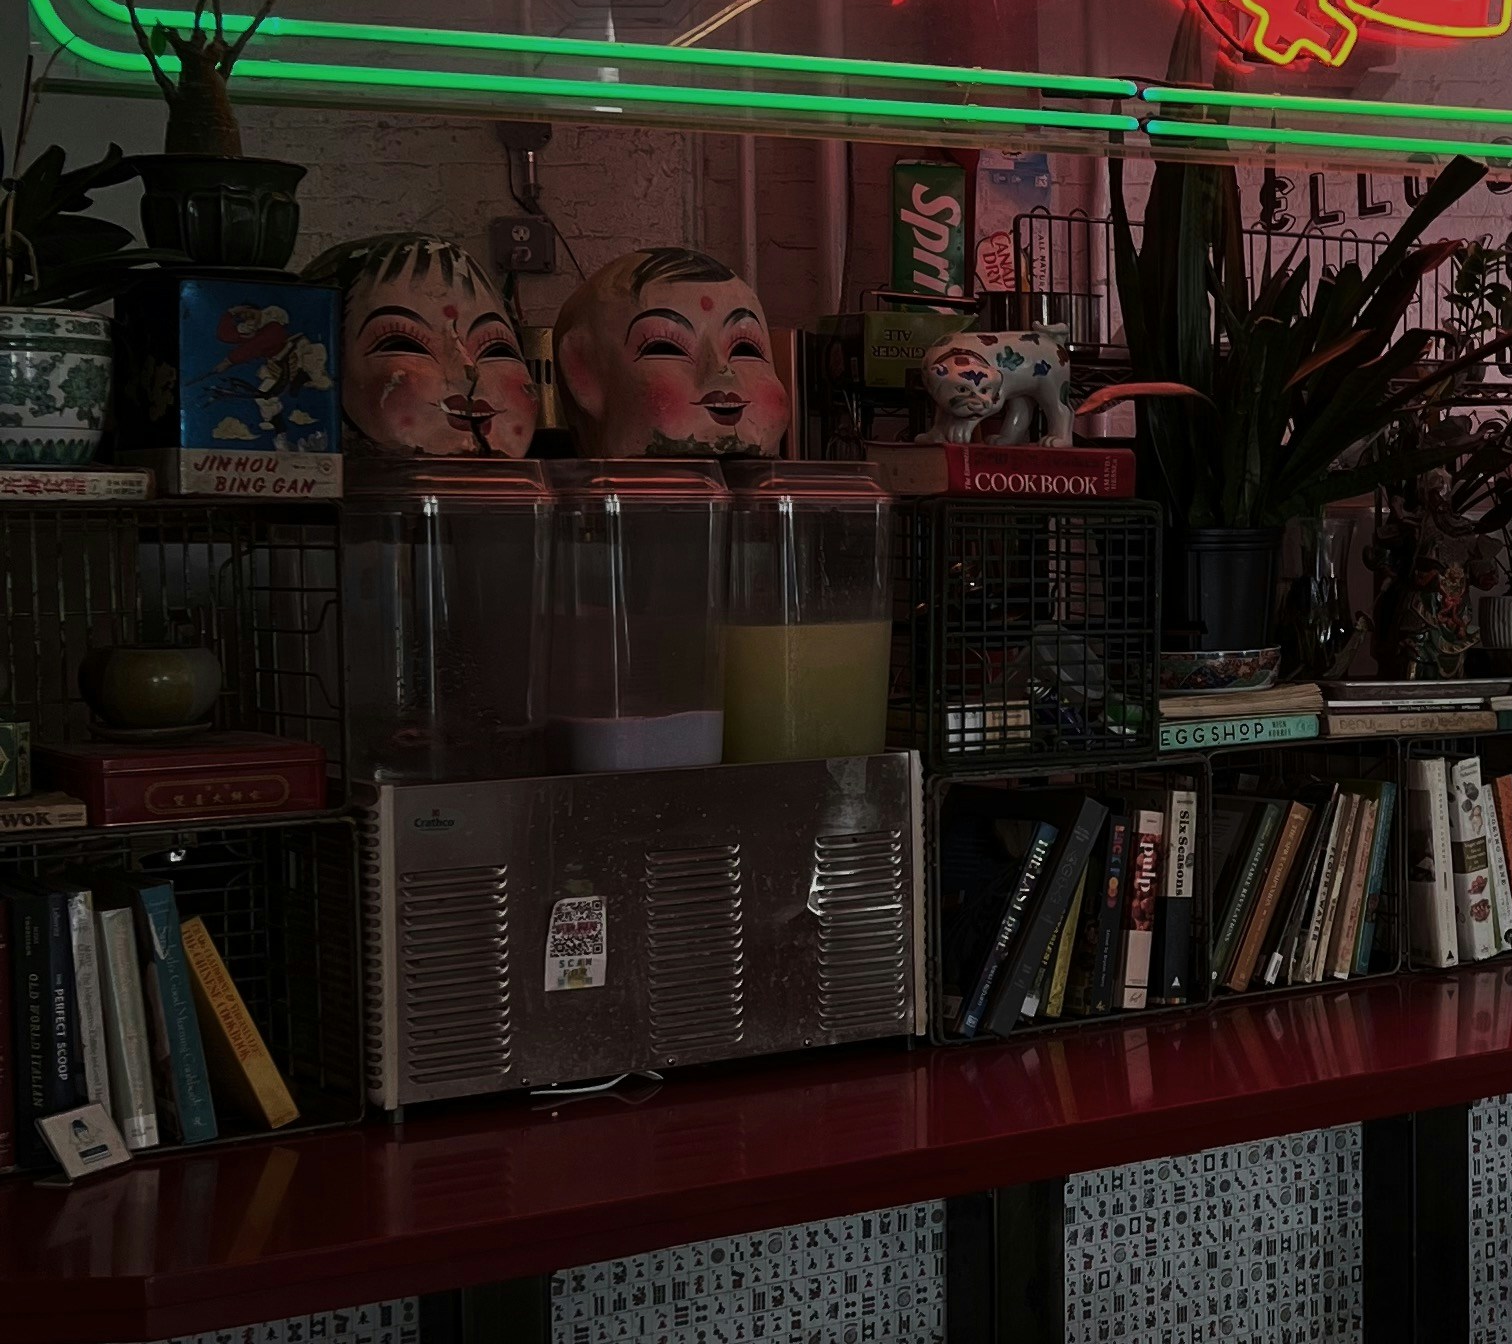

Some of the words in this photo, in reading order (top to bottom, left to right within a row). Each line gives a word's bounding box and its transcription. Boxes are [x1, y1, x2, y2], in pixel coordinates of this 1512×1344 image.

[900, 182, 962, 315] Spri
[982, 251, 1004, 288] DRY
[989, 230, 1016, 290] CANAD
[872, 346, 926, 358] GINGER
[884, 327, 912, 342] ALE
[215, 475, 266, 493] BING
[272, 477, 316, 494] GAN
[974, 471, 1099, 496] COOKBOOK
[0, 811, 52, 828] WOK
[1179, 809, 1191, 836] Six
[1138, 841, 1158, 893] pulp
[1175, 837, 1190, 897] Seasons
[1243, 842, 1266, 888] VEGETABLE
[1325, 846, 1337, 888] FLOUR
[1224, 887, 1249, 943] REVELATIONS
[1311, 901, 1325, 942] WATER
[29, 972, 42, 997] OLD
[28, 1000, 44, 1050] WORLD
[53, 987, 67, 1037] PERFECT
[215, 1000, 251, 1062] COOKBOOK
[30, 1052, 46, 1109] ITALIAN
[55, 1038, 69, 1082] SCOOP
